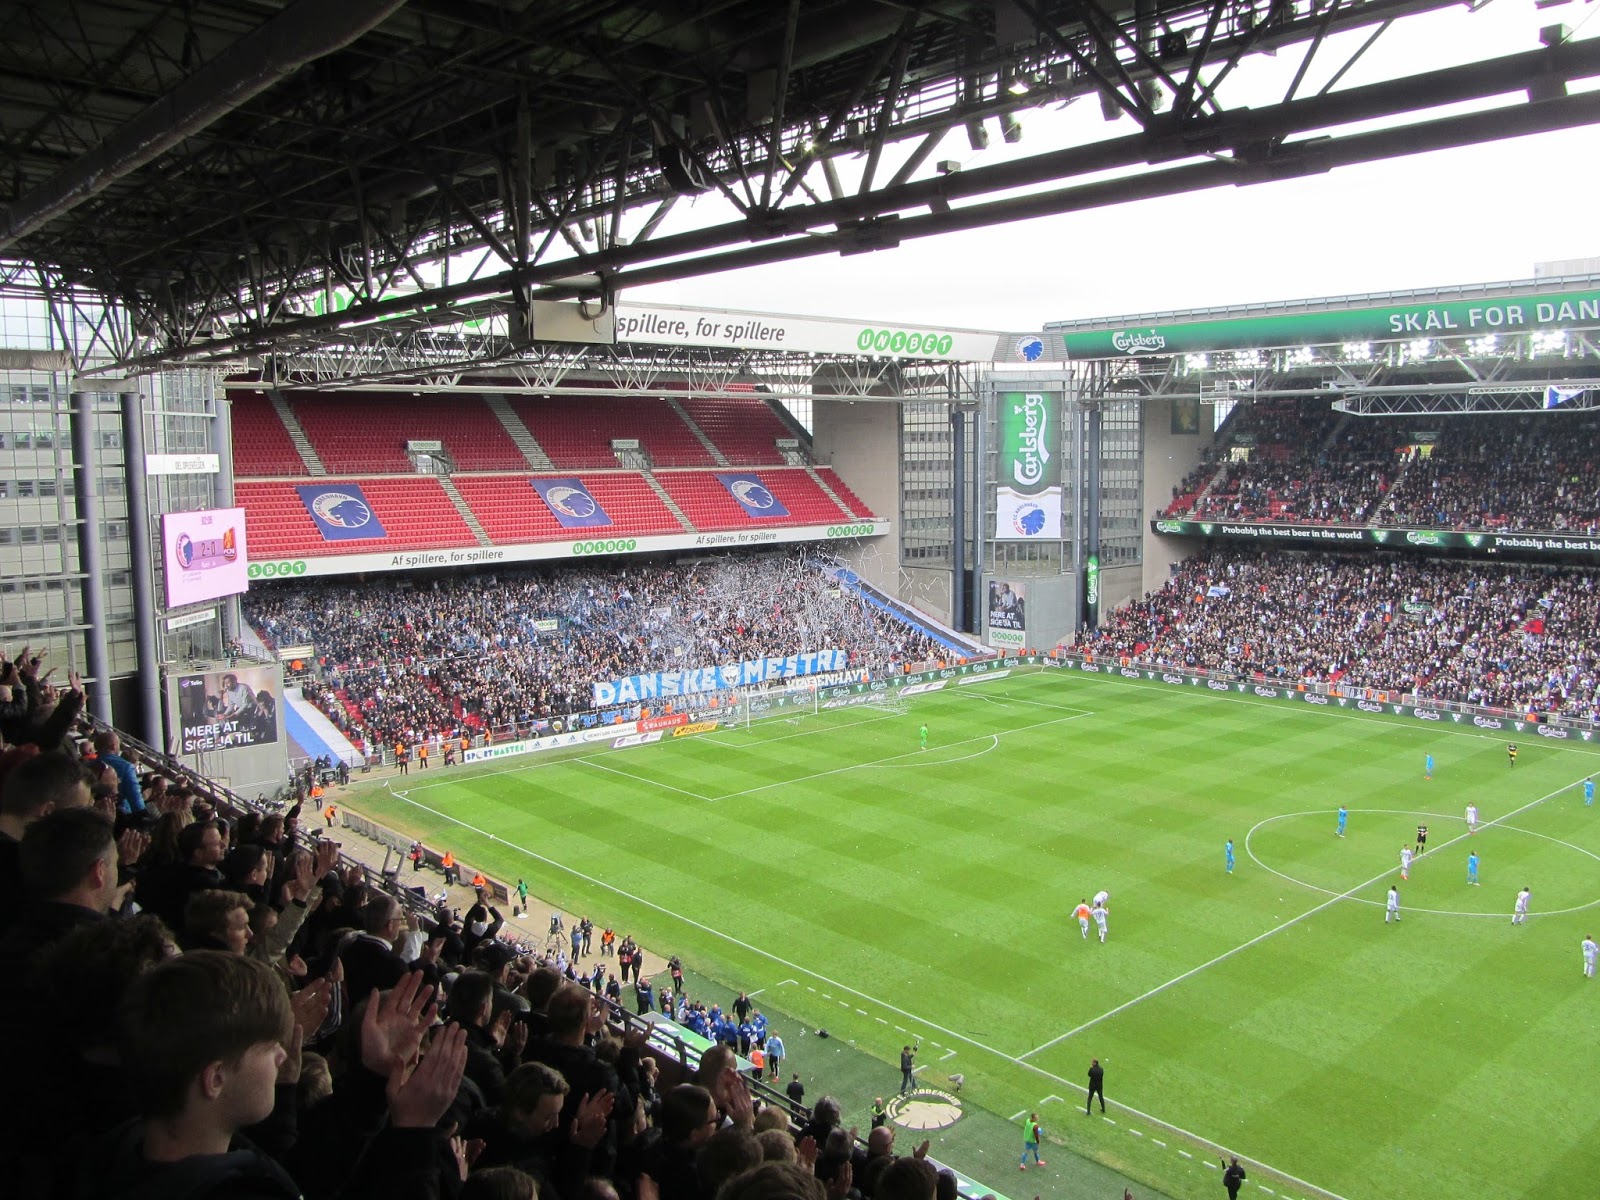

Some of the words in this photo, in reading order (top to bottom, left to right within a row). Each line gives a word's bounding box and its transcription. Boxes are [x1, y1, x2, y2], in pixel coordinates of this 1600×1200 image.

[1389, 310, 1458, 333] SKÅL
[1468, 306, 1523, 327] FOR
[1536, 300, 1600, 323] DAN
[617, 314, 690, 338] spillere,
[695, 318, 721, 337] for
[723, 321, 785, 343] spillere
[859, 331, 951, 353] UNIBET
[1112, 331, 1166, 353] Carlsberg
[1014, 394, 1050, 486] Carlsberg
[696, 535, 706, 545] Af
[706, 533, 737, 545] spillere,
[738, 533, 749, 542] for
[750, 532, 777, 543] spillere
[1222, 526, 1258, 536] Probably
[1259, 527, 1272, 535] the
[1273, 528, 1291, 536] best
[1292, 529, 1310, 537] beer
[1312, 529, 1320, 537] in
[1321, 529, 1335, 538] the
[1336, 530, 1363, 539] world
[1406, 531, 1439, 545] Carlsberg
[574, 540, 636, 553] UNIBET
[1495, 538, 1543, 549] Probably
[1544, 538, 1562, 548] the
[1564, 540, 1588, 550] best
[391, 555, 404, 566] Af
[406, 552, 447, 566] spillere,
[450, 550, 465, 562] for
[467, 549, 504, 562] spillere
[1087, 575, 1098, 604] Carlsberg
[594, 667, 717, 707] DANSKE
[1304, 693, 1328, 705] Carlsberg
[1357, 700, 1383, 712] Carlsberg
[1414, 707, 1440, 721] Carlsberg
[184, 724, 220, 738] MERE
[223, 721, 239, 733] AT
[649, 717, 683, 729] BAUHAUS
[1473, 716, 1502, 729] Carlsberg
[1537, 725, 1568, 738] Carlsberg
[185, 737, 215, 751] SIGE
[236, 732, 255, 744] TIL
